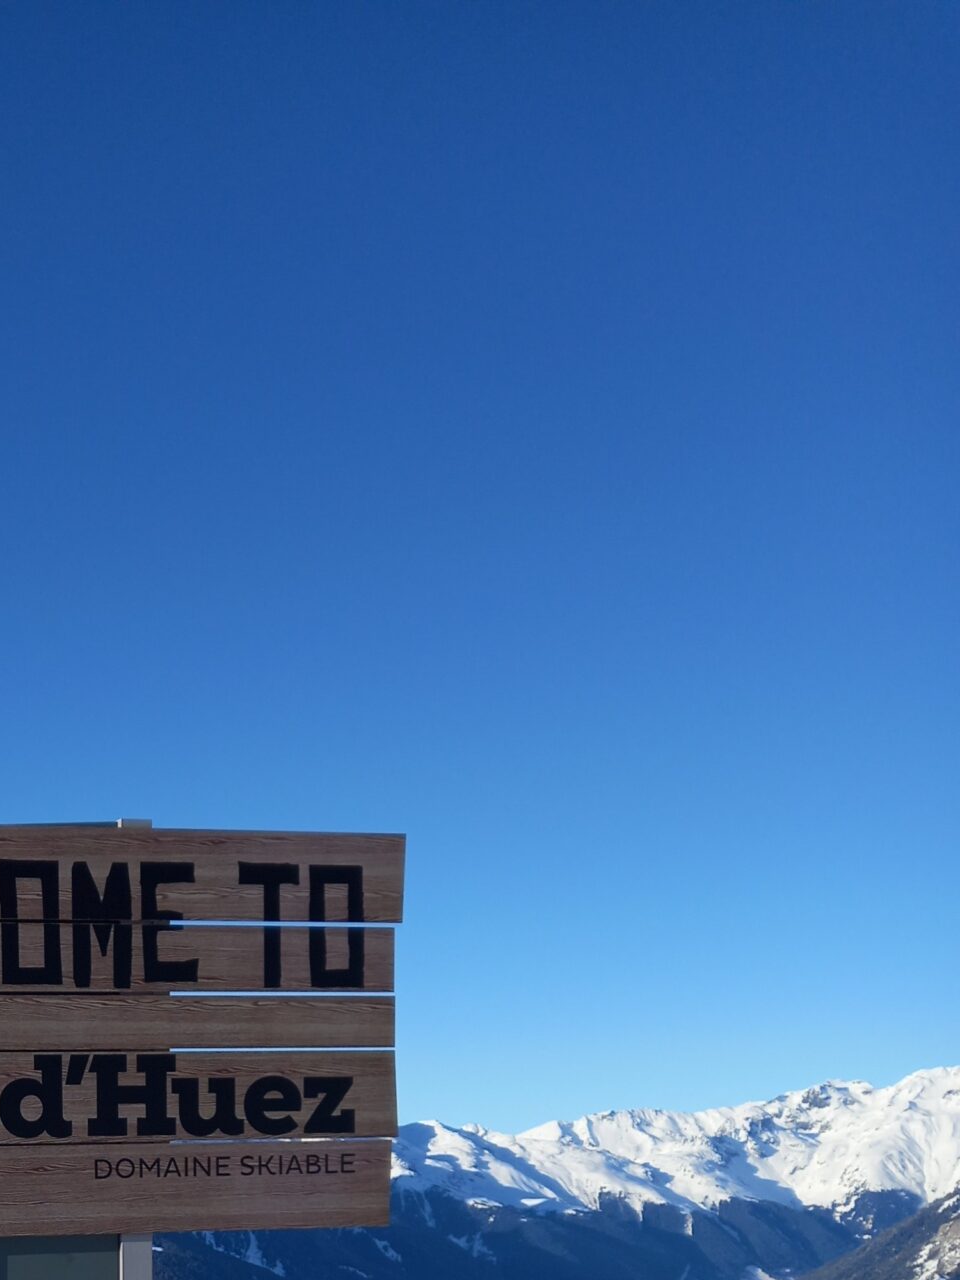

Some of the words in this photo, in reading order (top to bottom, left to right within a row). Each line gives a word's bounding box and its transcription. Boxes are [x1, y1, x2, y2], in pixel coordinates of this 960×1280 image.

[239, 861, 364, 988] TO
[94, 1156, 231, 1181] DOMAINE
[239, 1153, 357, 1177] SKIABLE
